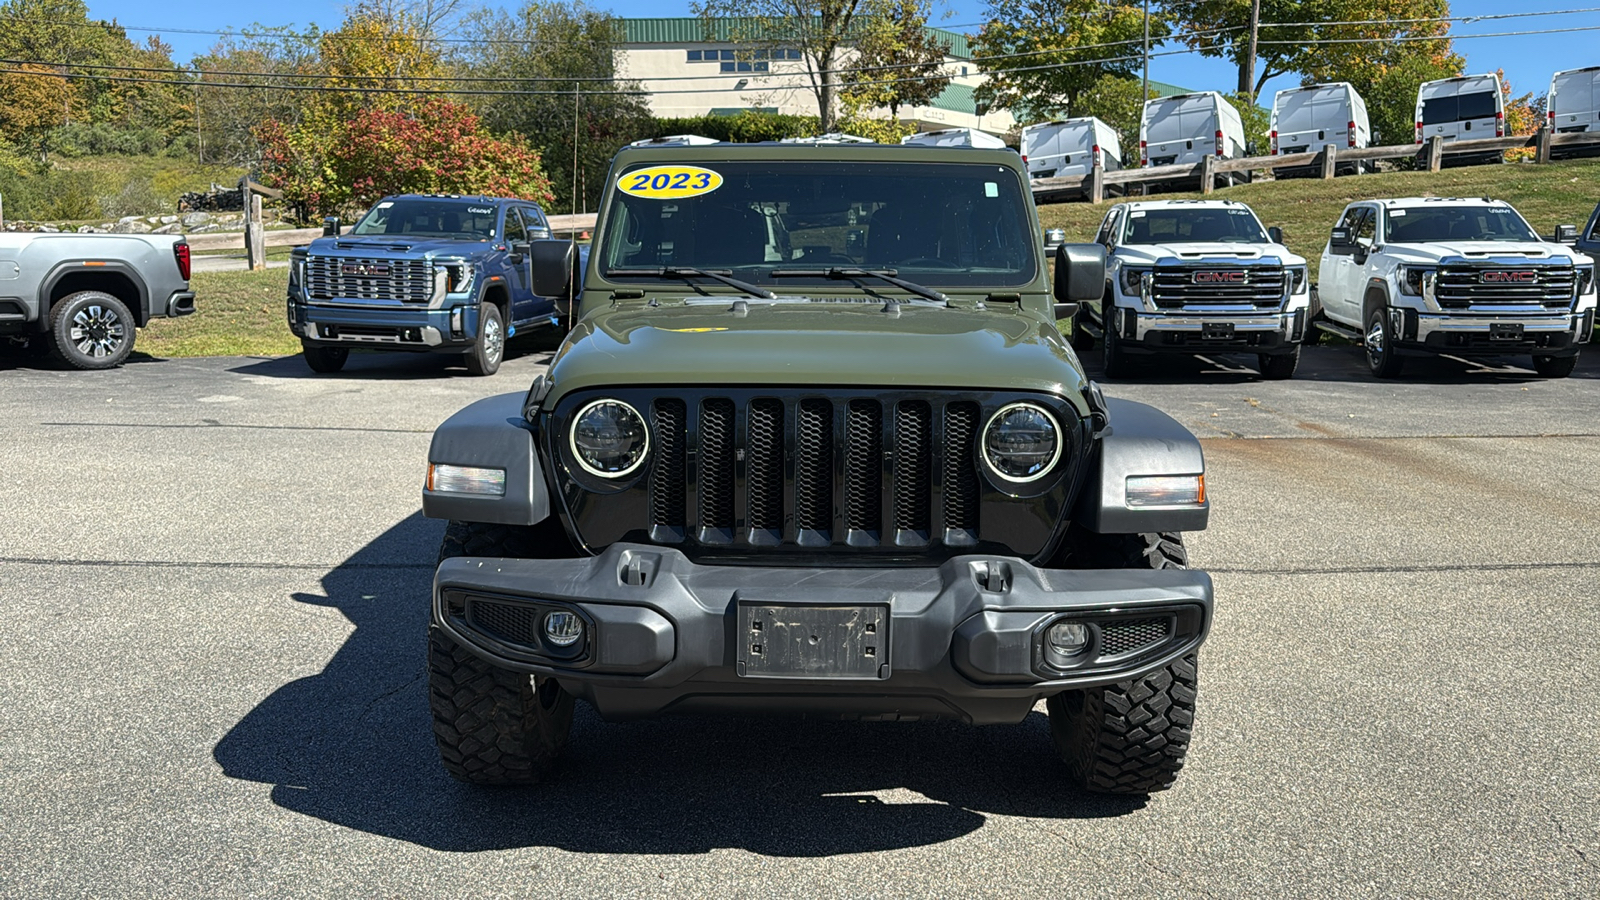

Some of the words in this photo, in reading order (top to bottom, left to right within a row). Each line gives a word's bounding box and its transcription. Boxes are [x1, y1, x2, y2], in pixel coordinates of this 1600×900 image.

[629, 173, 711, 190] 2023
[342, 264, 389, 276] GMC
[1196, 272, 1244, 282] GMC
[1484, 272, 1534, 282] GMC
